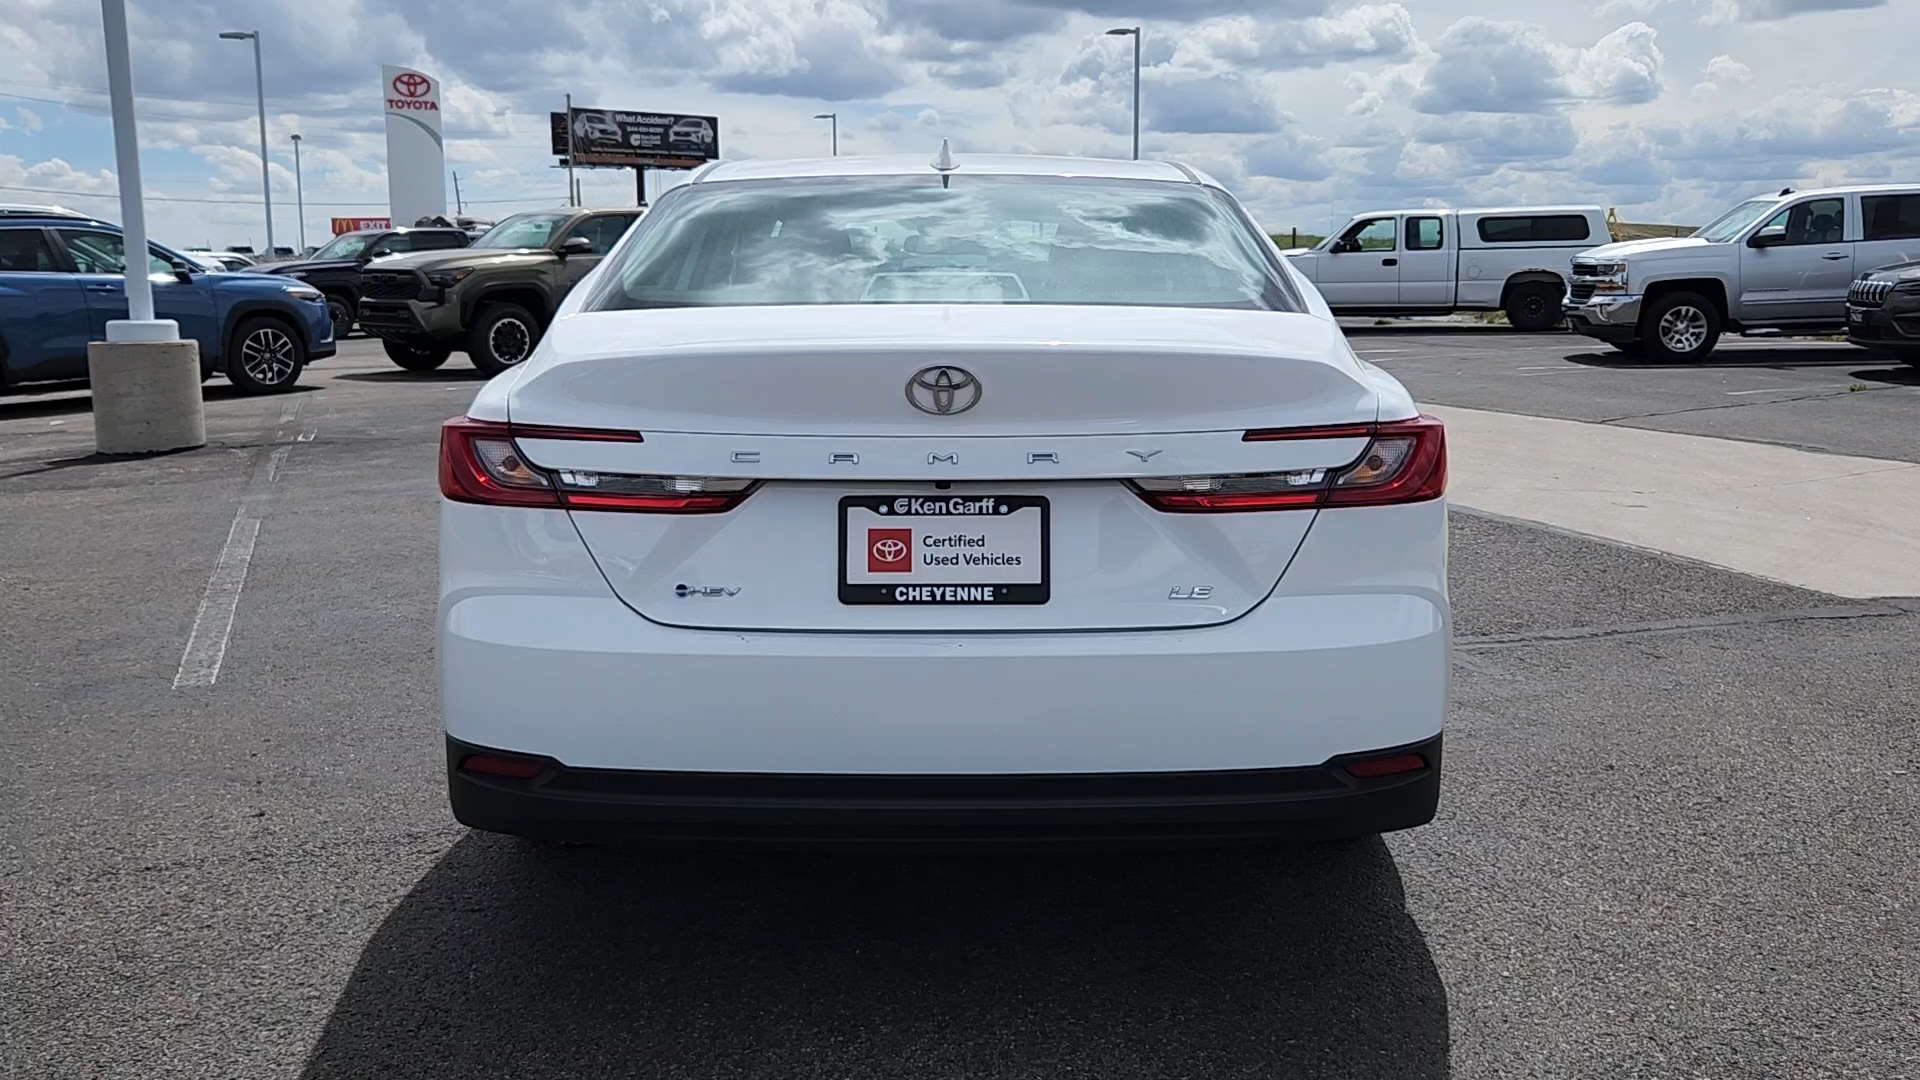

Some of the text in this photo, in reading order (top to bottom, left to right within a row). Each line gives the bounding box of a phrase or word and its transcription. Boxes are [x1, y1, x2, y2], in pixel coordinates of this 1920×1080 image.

[387, 99, 438, 111] TOYOTA
[615, 113, 675, 125] What Accident?
[360, 220, 388, 231] EXIT
[730, 450, 1163, 466] CAMRY
[911, 498, 994, 514] Ken Garff
[922, 535, 986, 548] Certified
[922, 553, 1022, 566] Used Vehicles
[894, 587, 994, 601] CHEYENNE
[1168, 586, 1214, 600] LE
